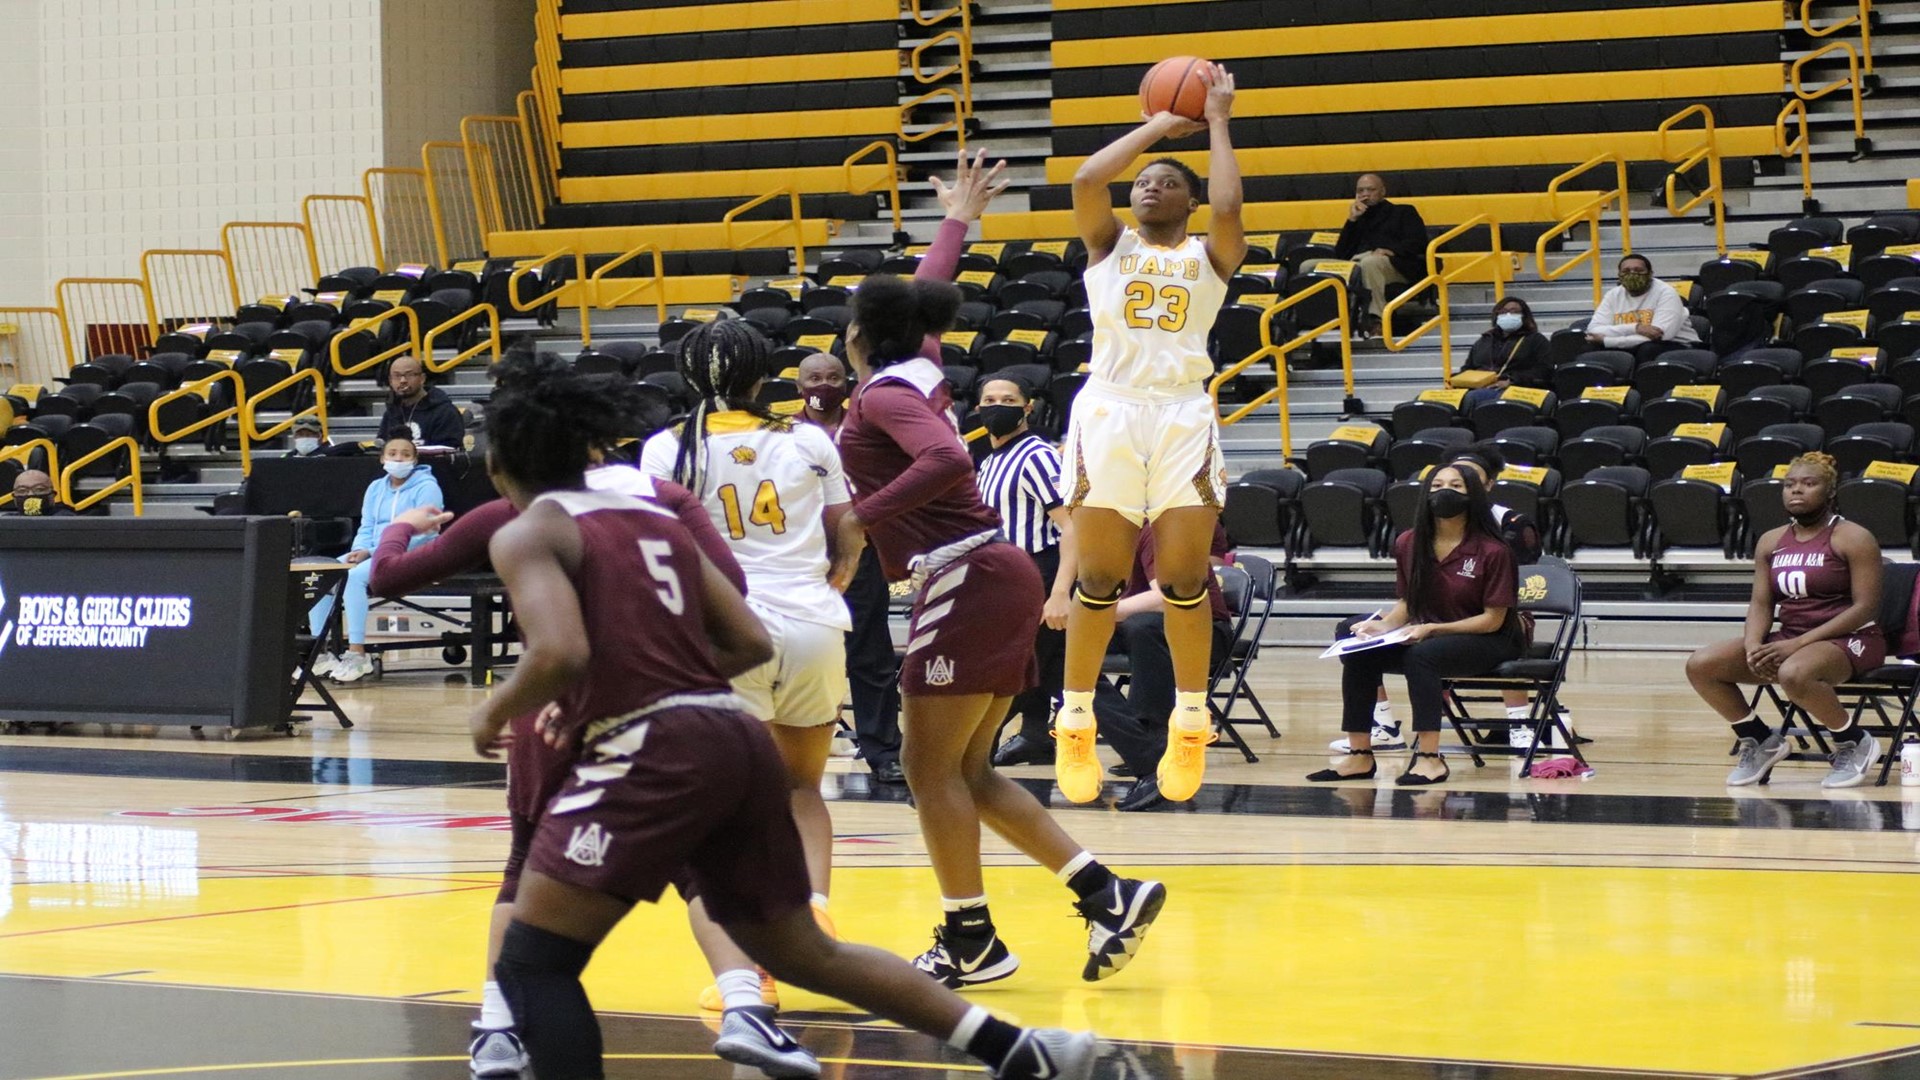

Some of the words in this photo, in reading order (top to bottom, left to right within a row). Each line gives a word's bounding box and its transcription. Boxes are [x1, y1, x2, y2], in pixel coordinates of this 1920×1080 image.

[1119, 253, 1200, 281] UAPB
[1124, 280, 1190, 333] 23
[718, 479, 786, 540] 14
[1804, 553, 1824, 567] A&M
[637, 539, 685, 616] 5
[1777, 570, 1808, 599] 10
[18, 595, 63, 625] BOYS
[64, 596, 80, 625] &
[81, 596, 133, 626] GIRLS
[134, 597, 192, 627] CLUBS
[16, 626, 33, 646] OF
[33, 626, 99, 647] JEFFERSON
[99, 627, 148, 647] COUNTY
